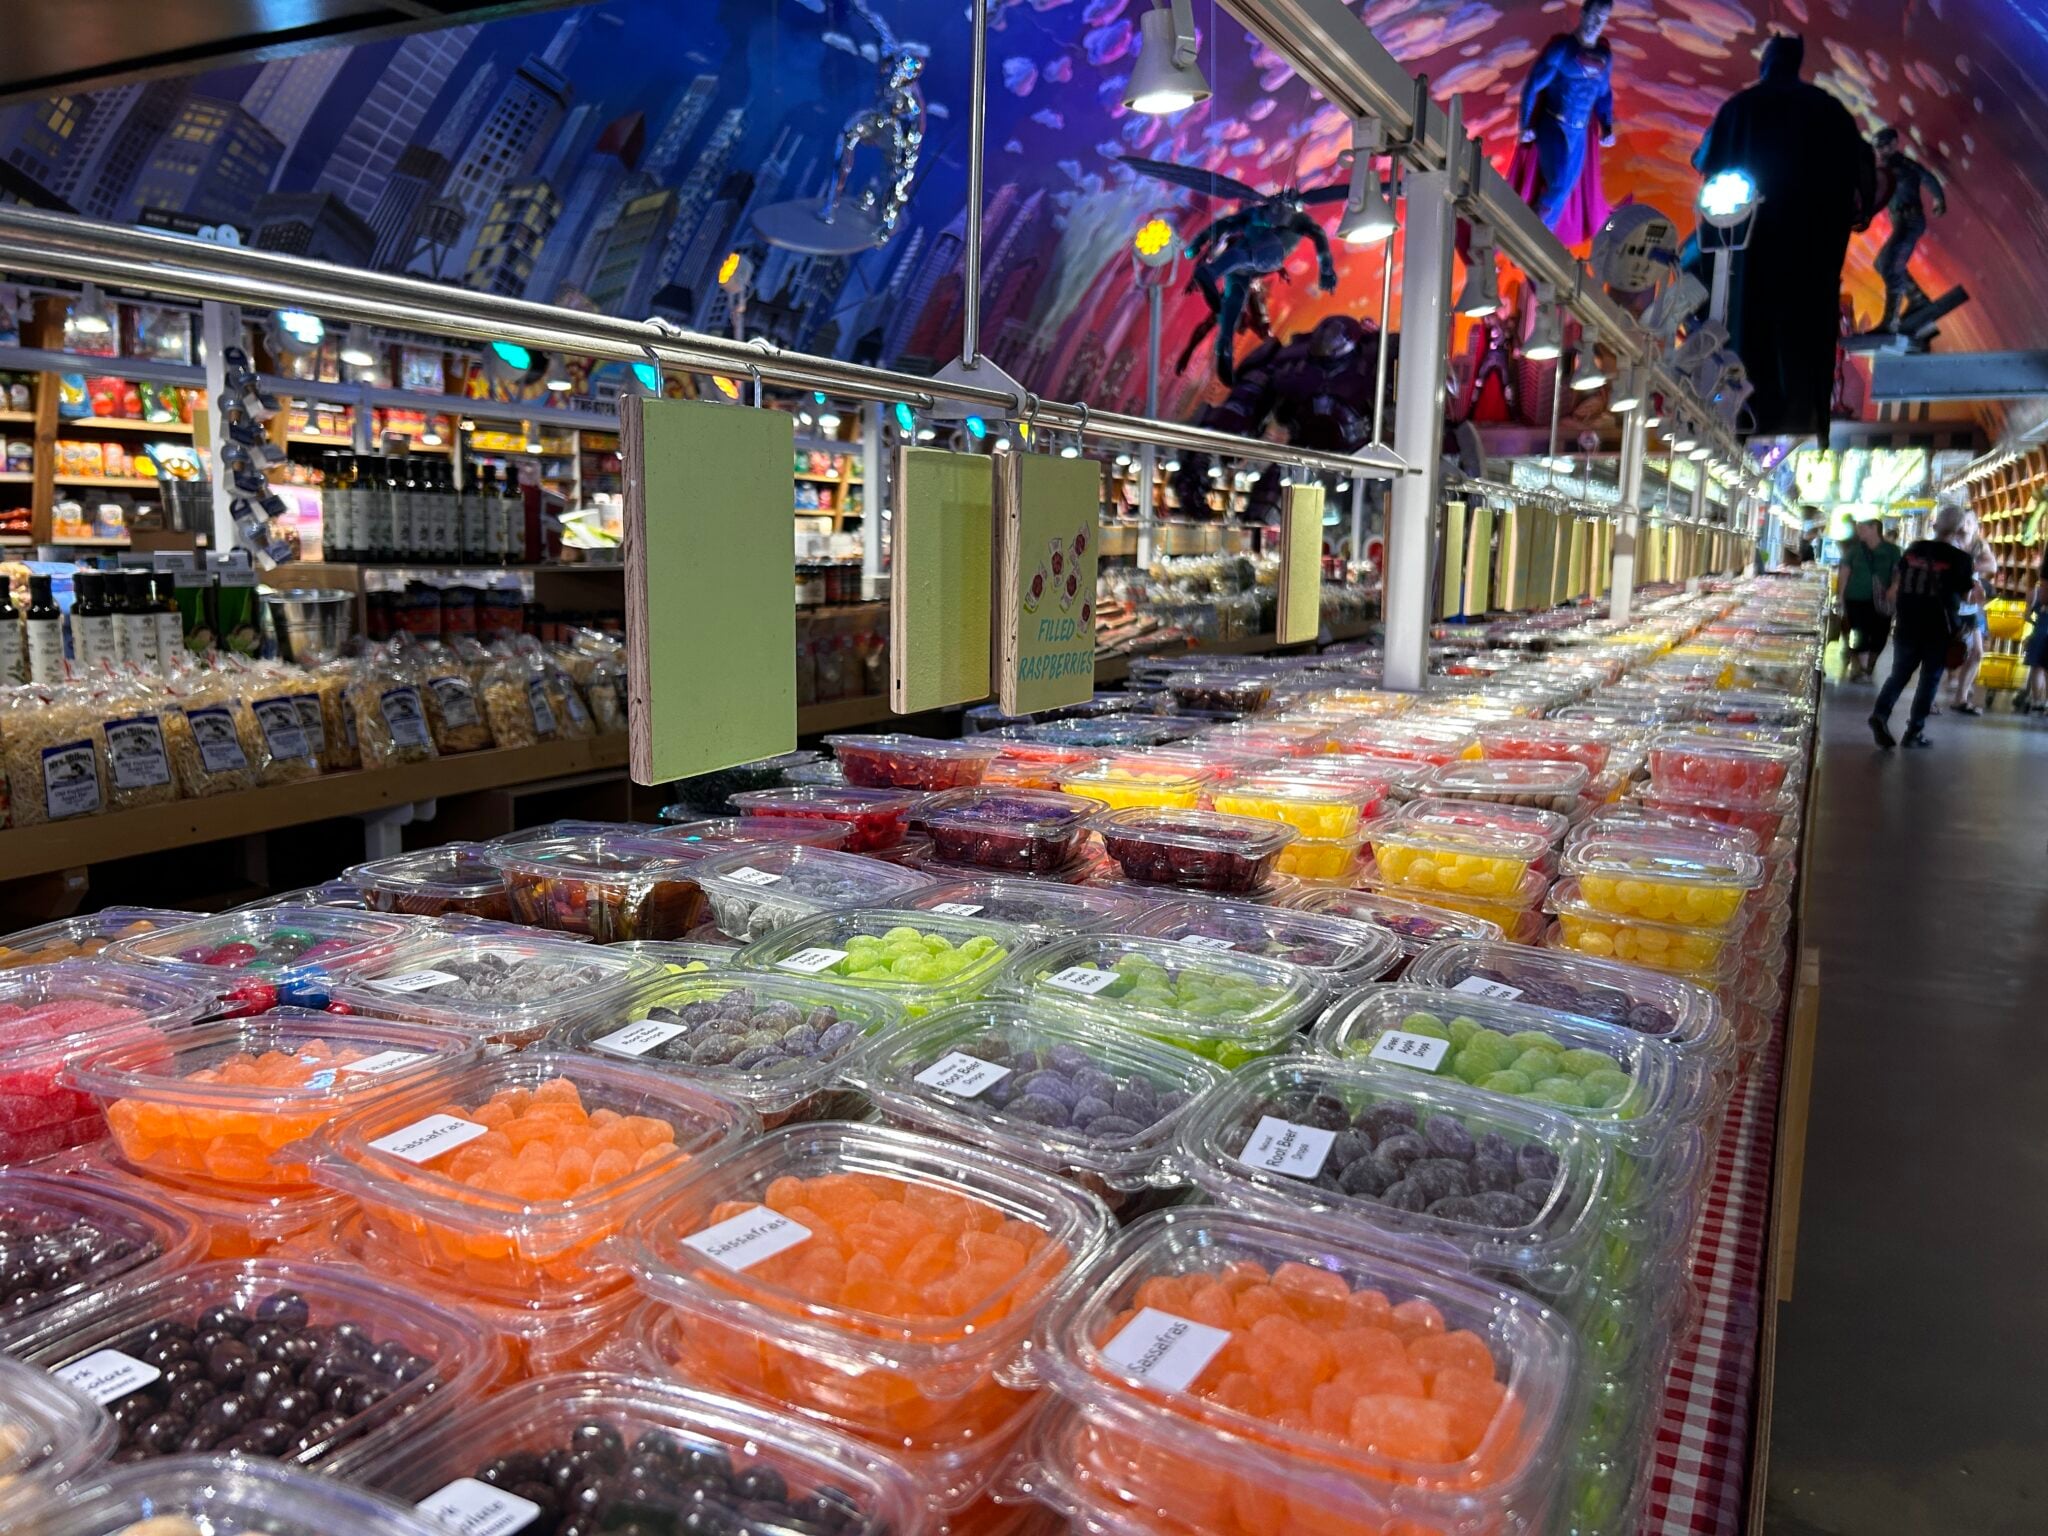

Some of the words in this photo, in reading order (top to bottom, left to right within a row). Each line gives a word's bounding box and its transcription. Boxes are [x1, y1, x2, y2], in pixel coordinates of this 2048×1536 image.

[1038, 618, 1076, 642] FILLED
[1018, 651, 1094, 681] RASPBERRIES
[621, 1035, 643, 1045] Root
[640, 1026, 659, 1036] Beer
[639, 1031, 664, 1043] Drops
[1382, 1036, 1400, 1051] Green
[1398, 1040, 1415, 1054] Apple
[1413, 1042, 1431, 1057] Drops
[936, 1073, 963, 1087] Root
[957, 1061, 982, 1074] Beer
[962, 1072, 985, 1085] Drops
[392, 1121, 465, 1153] Sassafras
[1276, 1129, 1298, 1147] Beer
[1265, 1147, 1288, 1167] Root
[1291, 1143, 1309, 1160] Drops
[706, 1218, 788, 1256] Sassafras
[1127, 1321, 1189, 1374] Sassafras
